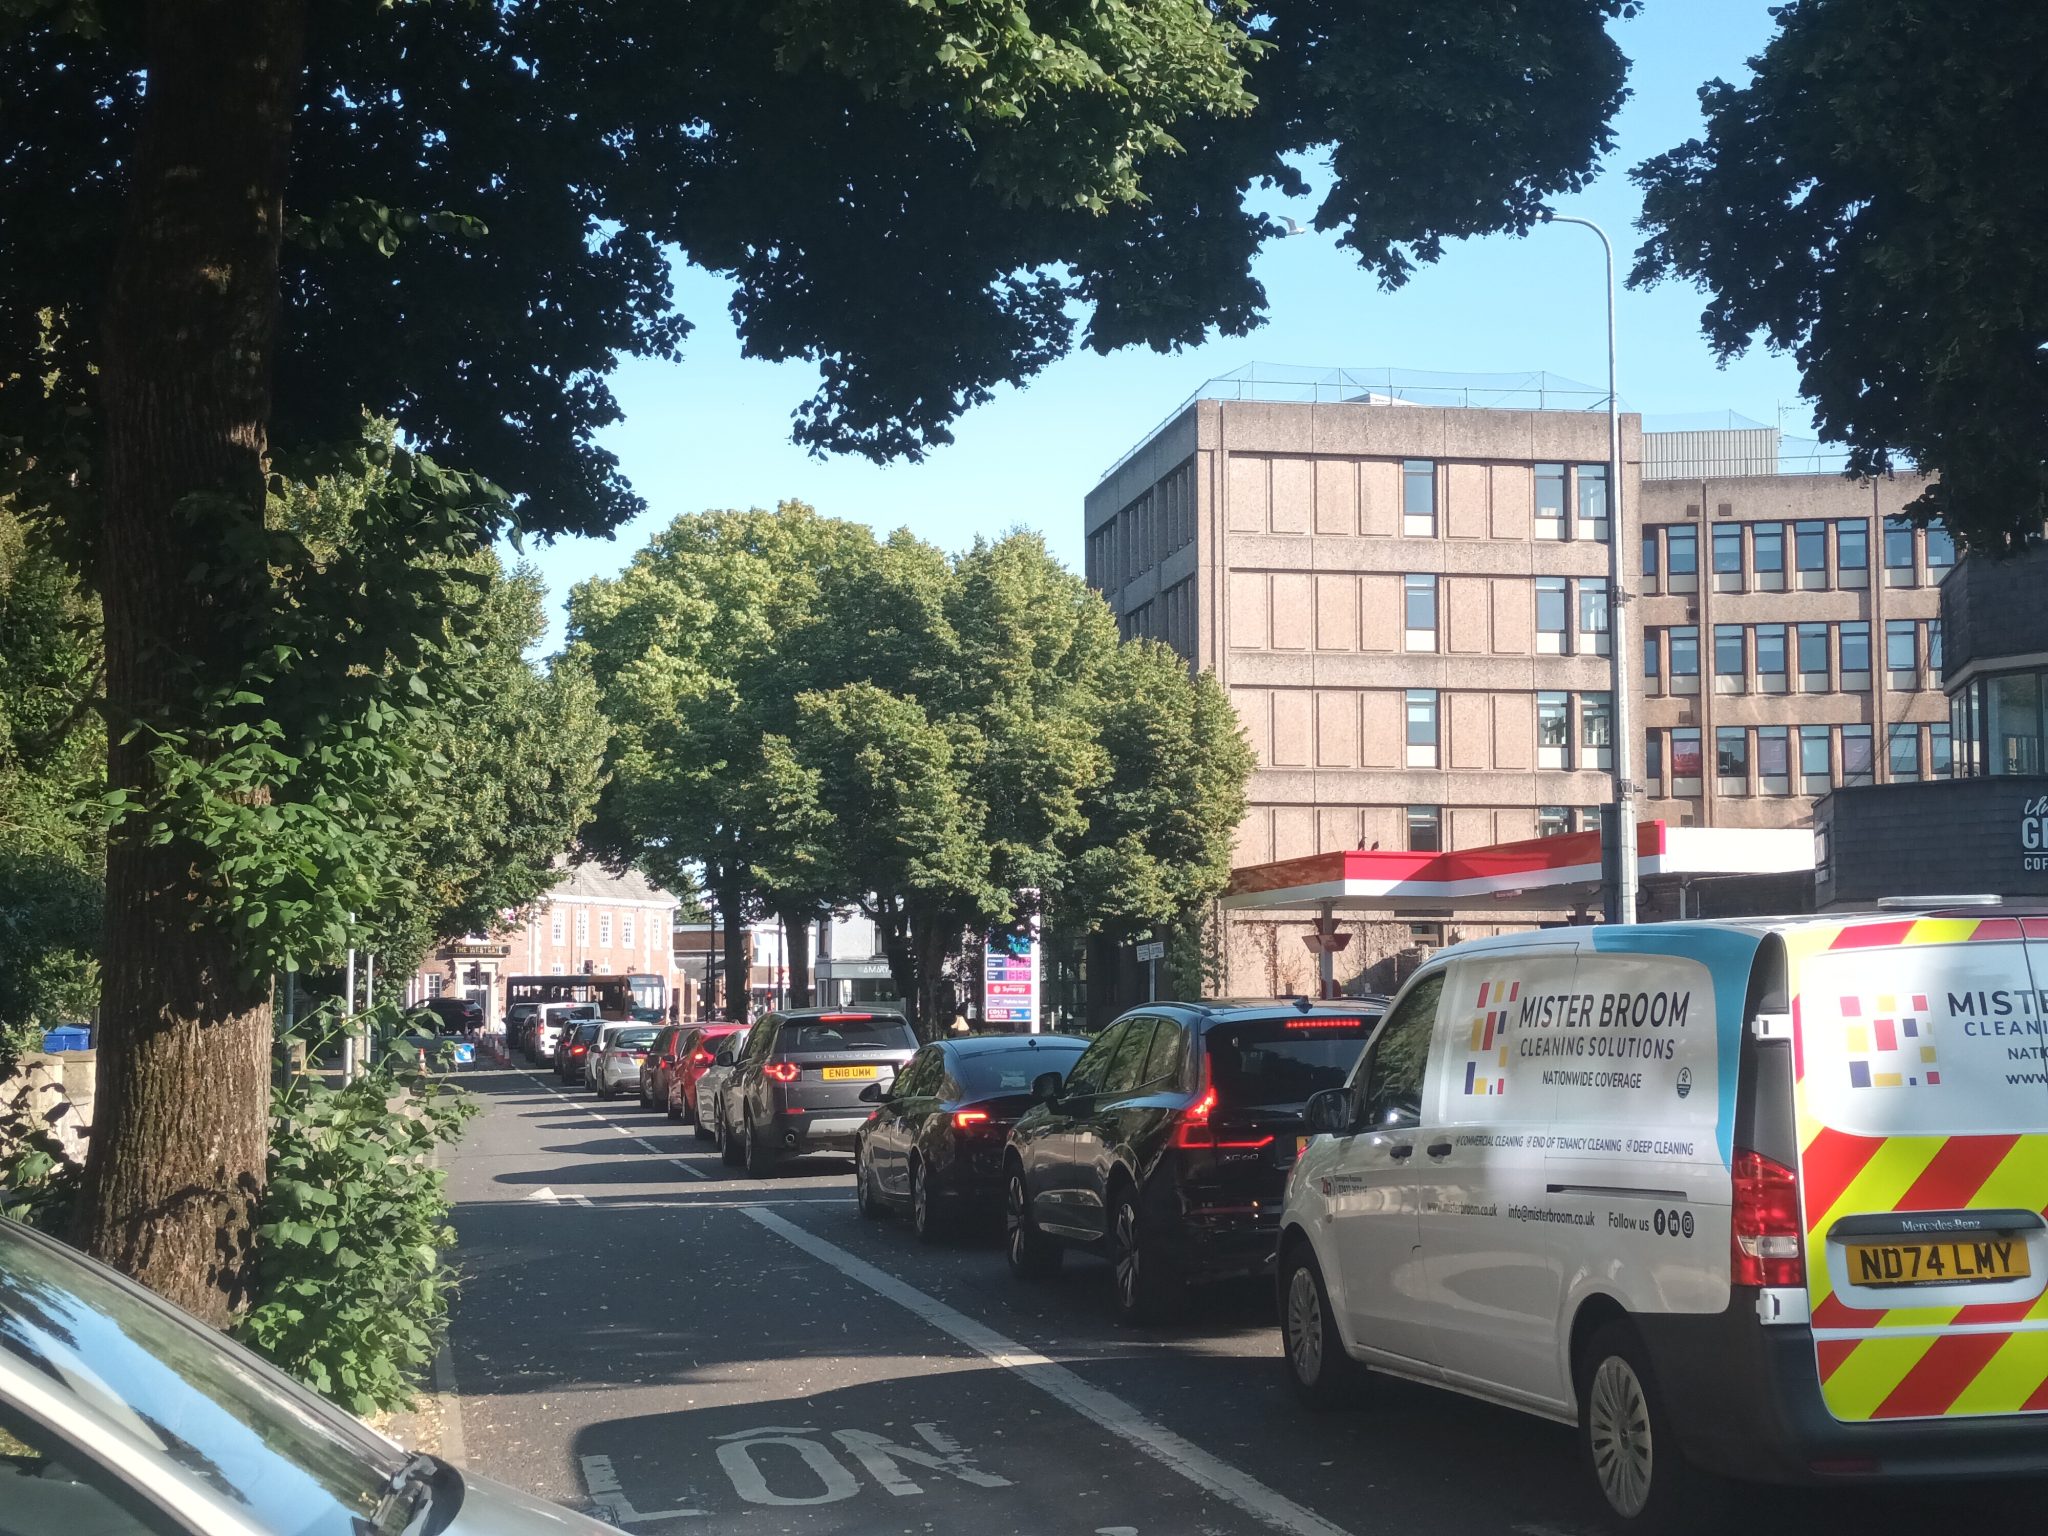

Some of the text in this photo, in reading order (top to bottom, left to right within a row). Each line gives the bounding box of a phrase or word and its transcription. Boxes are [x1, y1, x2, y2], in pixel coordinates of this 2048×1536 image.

[1519, 991, 1691, 1028] MISTER BROOM
[1520, 1036, 1675, 1060] CLEANING SOLUTIONS
[1542, 1070, 1643, 1089] NATIONWIDE COVERAGE
[1495, 1135, 1524, 1148] CLEANING
[1532, 1136, 1546, 1149] END
[1546, 1136, 1556, 1149] OF
[1556, 1137, 1588, 1150] TENANCY
[1587, 1138, 1622, 1152] CLEANING
[1633, 1140, 1653, 1154] DEEP
[1654, 1141, 1694, 1156] CLEANING
[1508, 1203, 1649, 1232] info@misterbroom.co.uk Follow us
[1902, 1219, 1981, 1232] Mercedes-Benz
[1860, 1241, 2012, 1280] ND74 LMY
